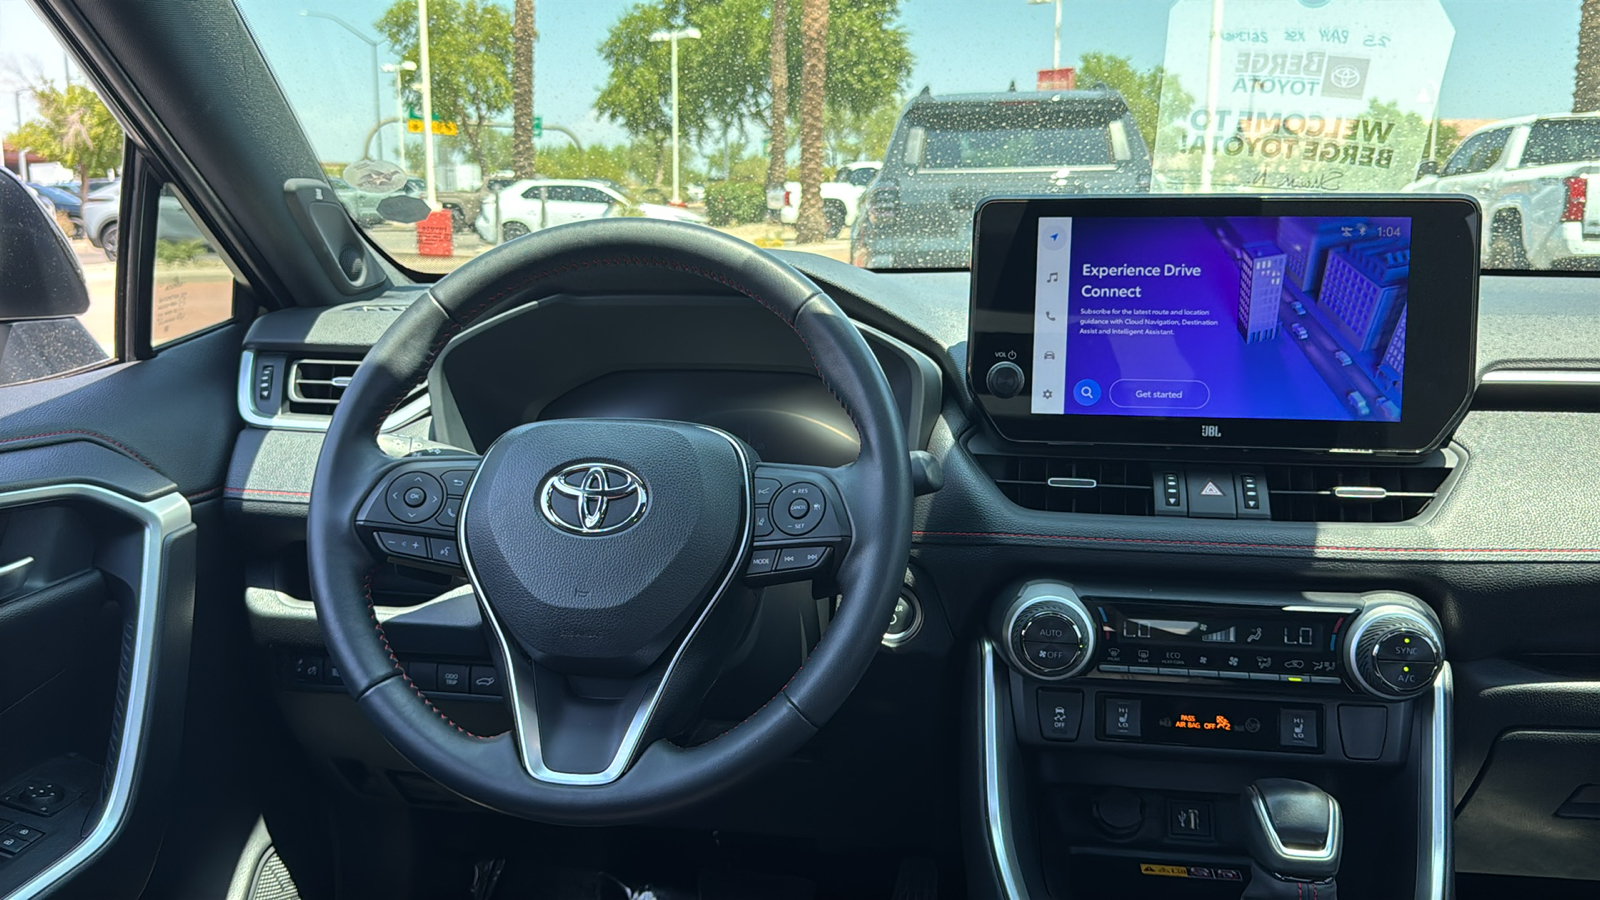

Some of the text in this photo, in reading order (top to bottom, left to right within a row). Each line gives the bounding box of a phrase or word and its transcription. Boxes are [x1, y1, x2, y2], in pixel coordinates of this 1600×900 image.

[1377, 226, 1401, 237] 1:04
[1082, 263, 1202, 279] Experience Drive
[1081, 285, 1142, 297] Connect
[1080, 318, 1109, 326] guidance
[1145, 319, 1180, 327] Navigation,
[1112, 328, 1143, 336] Intelligent
[1135, 390, 1183, 399] Get started
[1201, 425, 1222, 437] JBL
[1039, 629, 1063, 638] AUTO
[1395, 647, 1418, 655] SYNC
[1397, 674, 1415, 683] A/C
[1180, 714, 1196, 722] PASS
[1054, 721, 1065, 729] OFF
